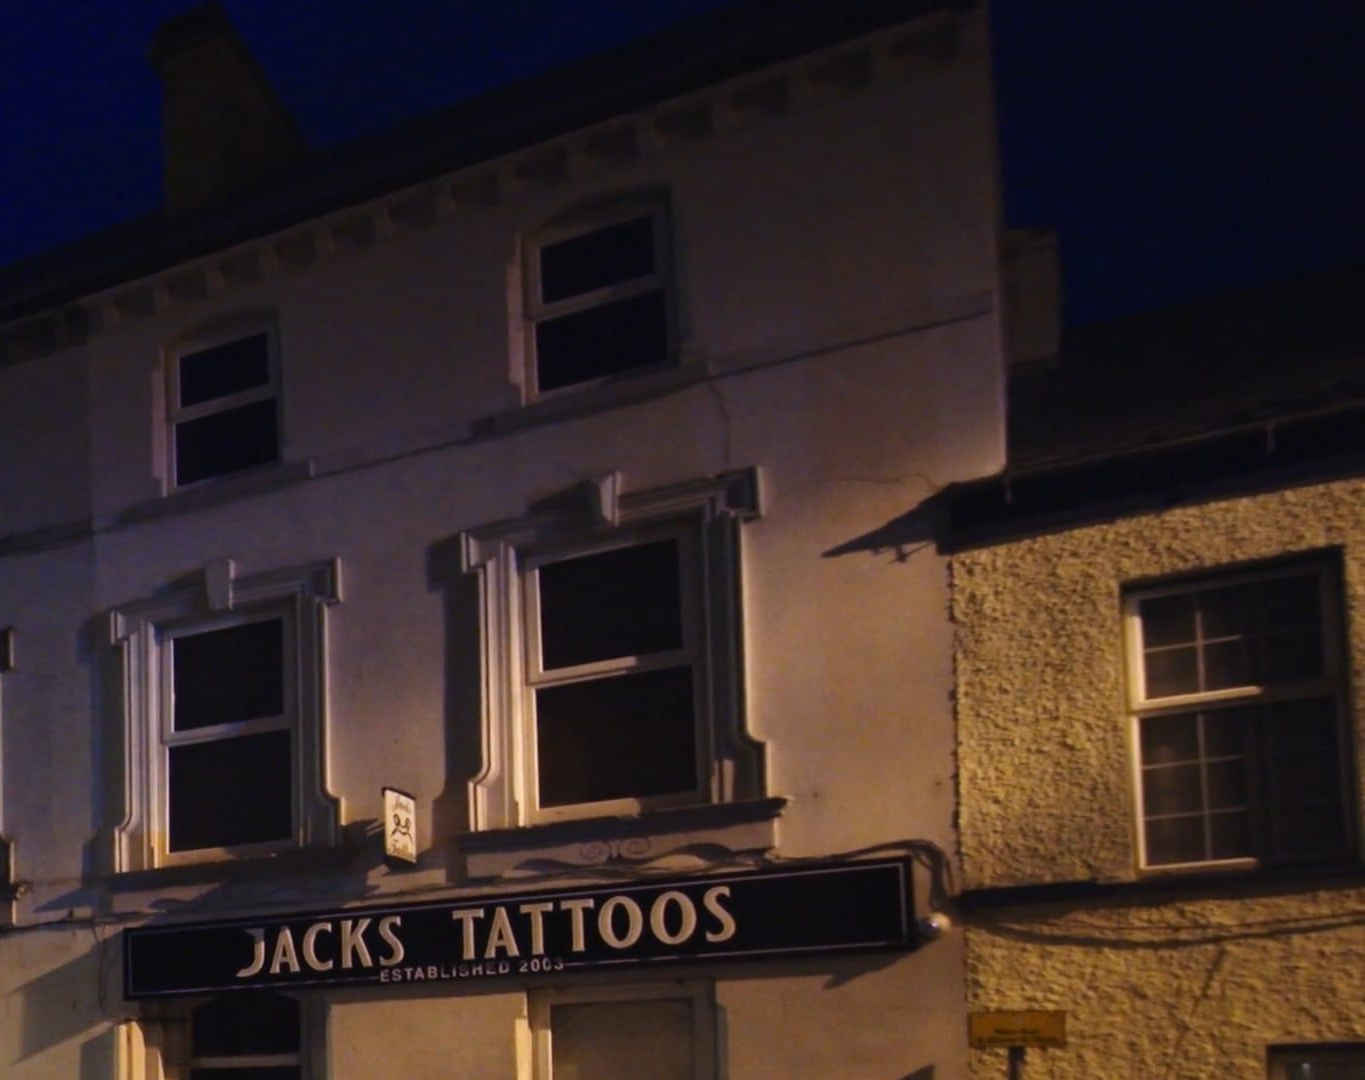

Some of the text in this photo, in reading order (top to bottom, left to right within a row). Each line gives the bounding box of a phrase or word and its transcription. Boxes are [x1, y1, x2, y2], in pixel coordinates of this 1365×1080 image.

[236, 886, 737, 977] JACKS TATTOOS
[379, 959, 510, 983] ESTABLISHED
